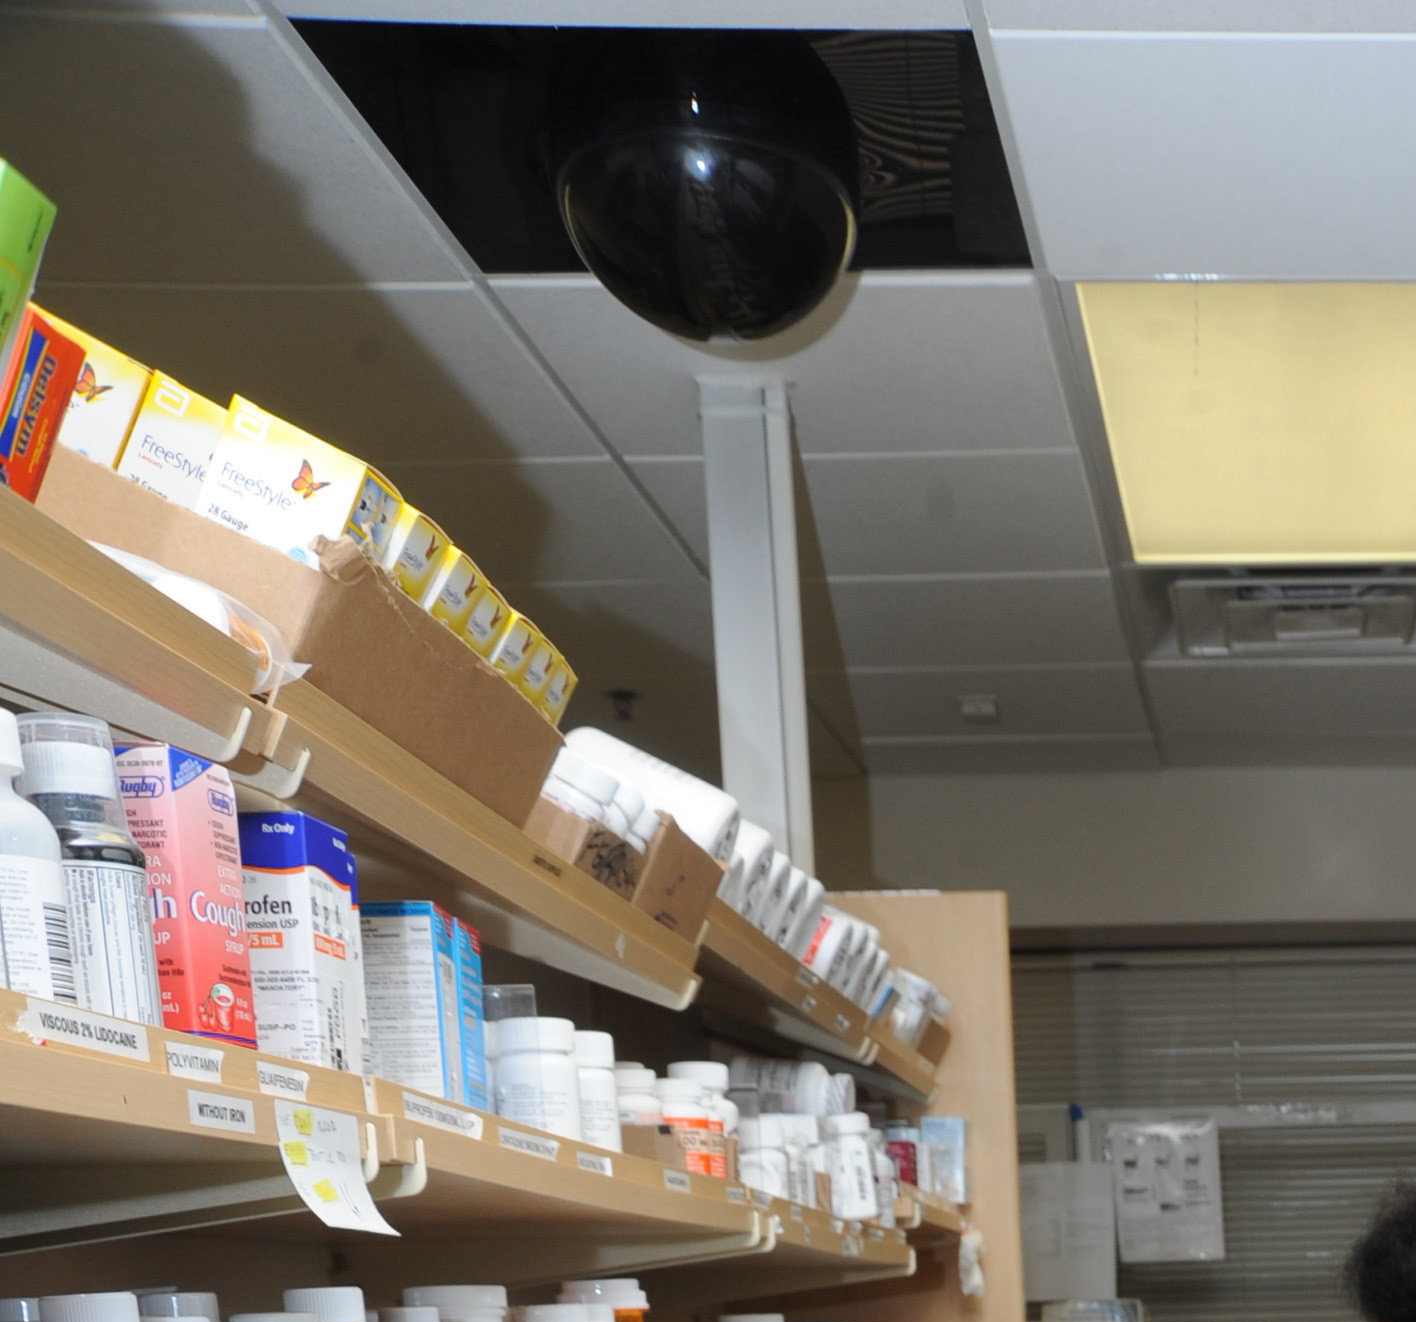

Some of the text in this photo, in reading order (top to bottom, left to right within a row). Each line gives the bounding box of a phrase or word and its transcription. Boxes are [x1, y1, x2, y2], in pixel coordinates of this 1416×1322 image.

[17, 355, 57, 456] Delsym
[141, 434, 207, 483] FreeStyle
[221, 461, 293, 511] FreeStyle
[208, 503, 249, 531] 28 Gauge
[120, 779, 156, 797] Rugby
[190, 890, 246, 937] Cough
[280, 919, 299, 929] USP
[261, 934, 280, 945] mL
[39, 1011, 138, 1050] VISCOUS 2% LIDOCAINE
[167, 1052, 219, 1074] POLYVITAMIN
[259, 1071, 305, 1092] GUAIFENESIN
[197, 1103, 246, 1123] WITHOUT IRON
